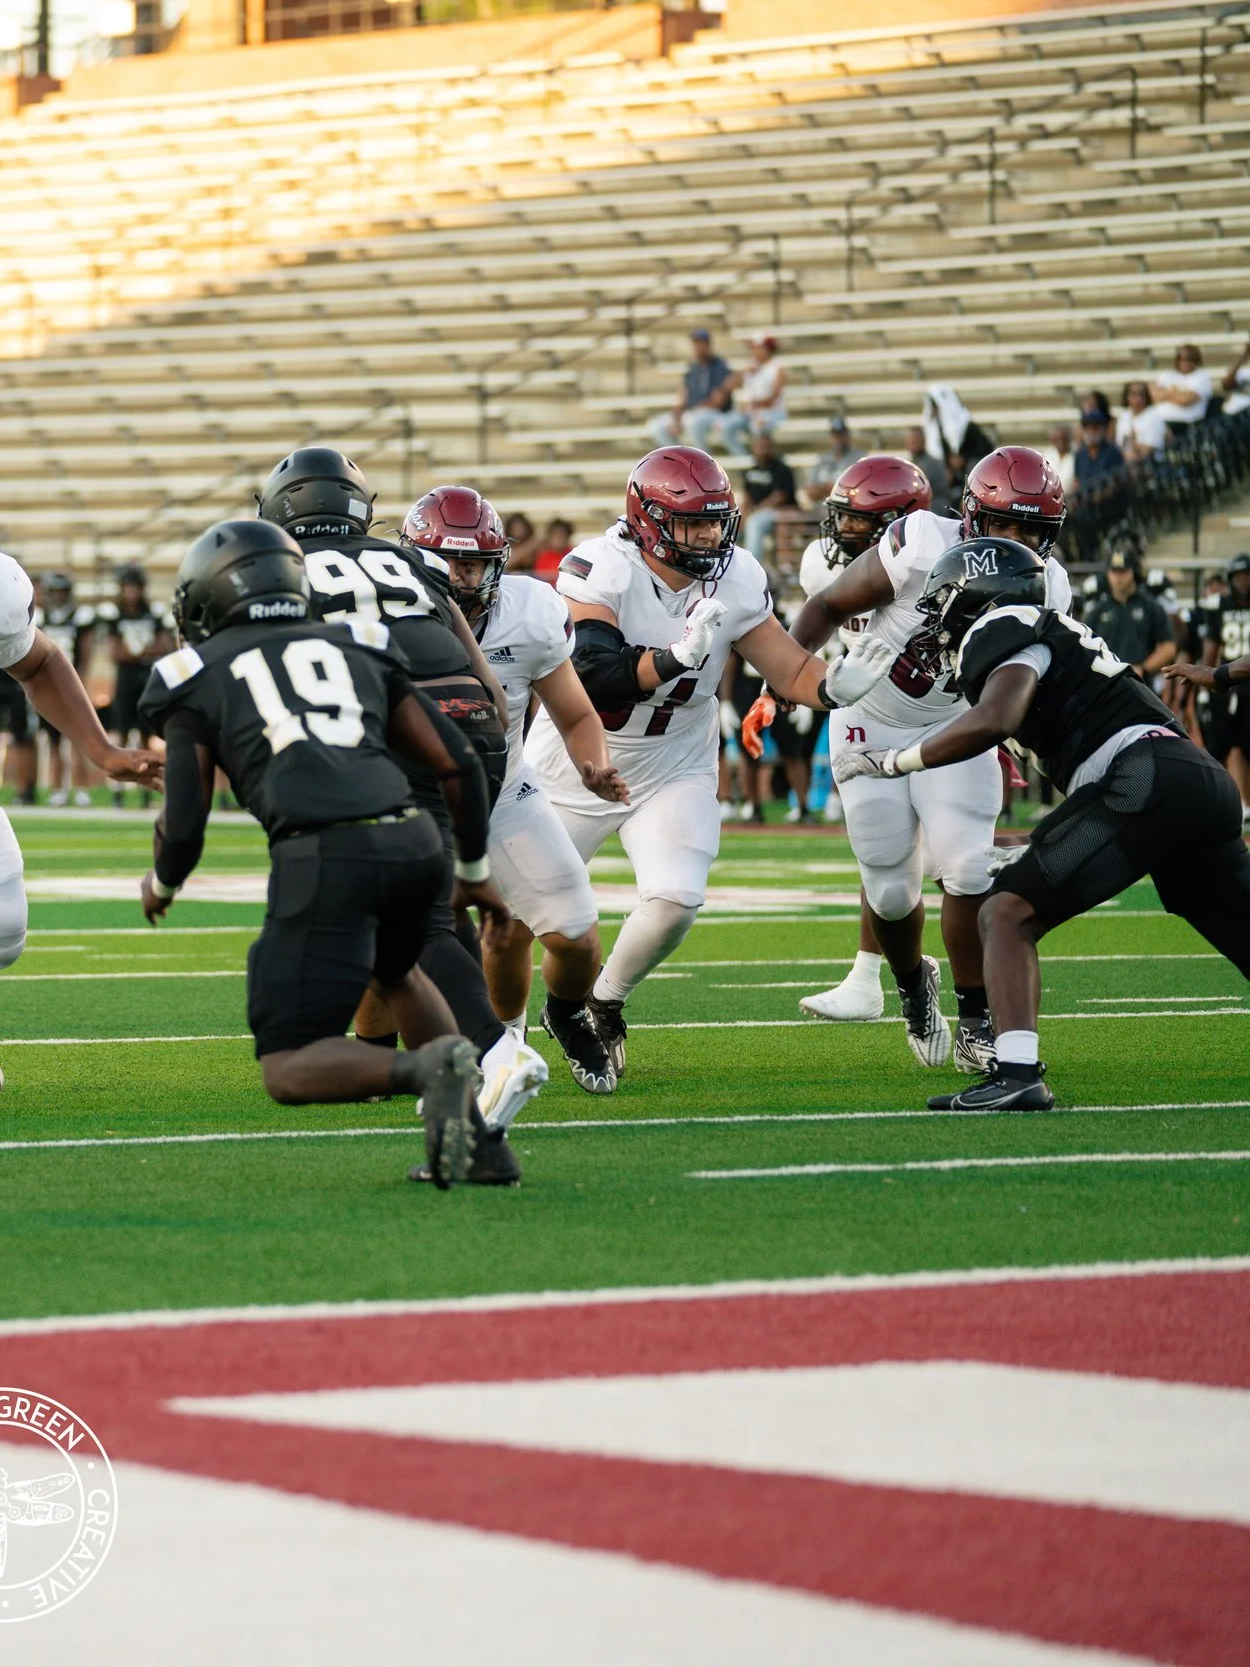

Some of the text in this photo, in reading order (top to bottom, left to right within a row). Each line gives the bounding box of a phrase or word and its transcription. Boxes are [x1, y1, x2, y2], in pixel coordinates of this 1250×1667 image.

[707, 502, 729, 510] Riddell
[1012, 502, 1040, 513] Riddell
[294, 524, 350, 535] Riddell
[447, 538, 475, 547] Riddell
[963, 548, 999, 580] M
[303, 549, 435, 624] 99
[249, 601, 307, 619] Riddell
[490, 653, 516, 663] adidas
[229, 638, 366, 755] 19
[516, 787, 539, 801] adidas
